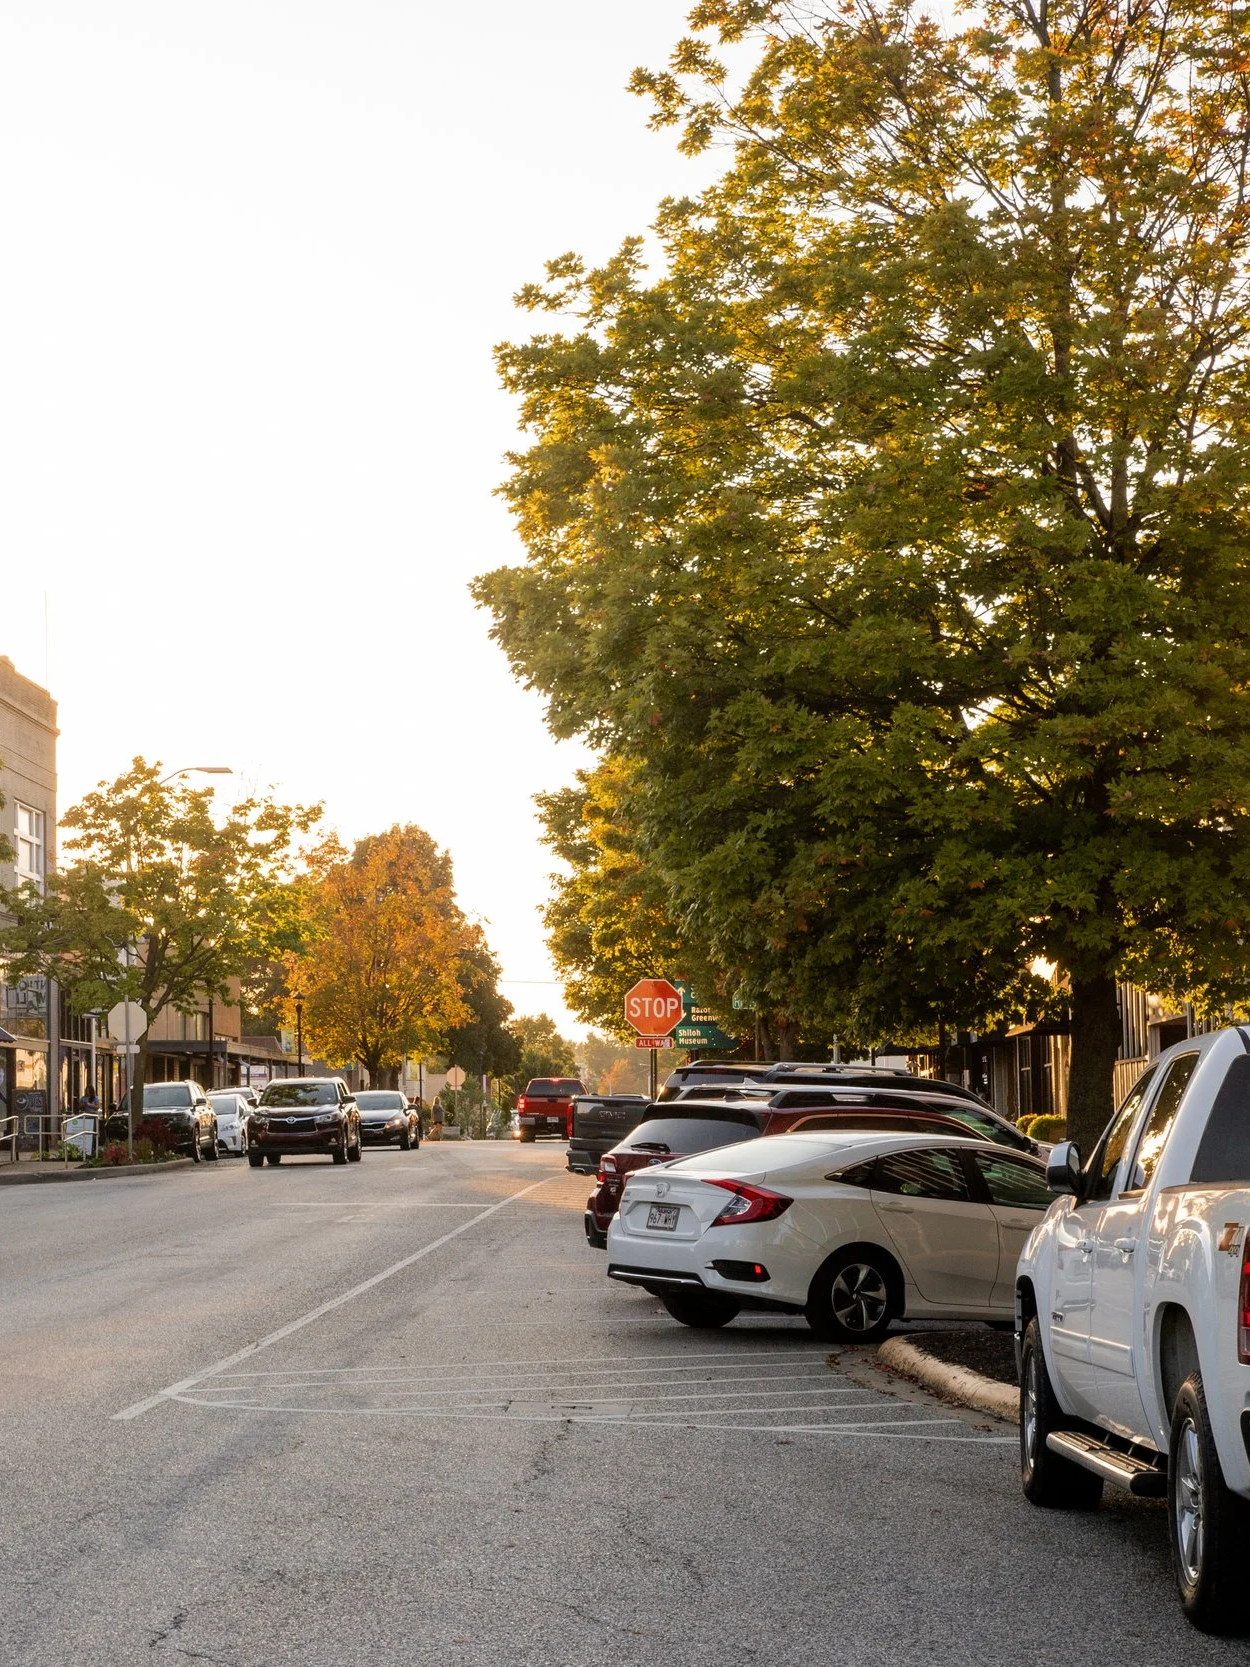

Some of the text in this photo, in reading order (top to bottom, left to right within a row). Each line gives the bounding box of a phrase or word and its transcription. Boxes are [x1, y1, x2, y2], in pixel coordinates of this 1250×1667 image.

[629, 997, 679, 1018] STOP
[691, 1014, 719, 1022] Greenw
[678, 1029, 701, 1037] Shiloh
[638, 1039, 670, 1048] ALL WA
